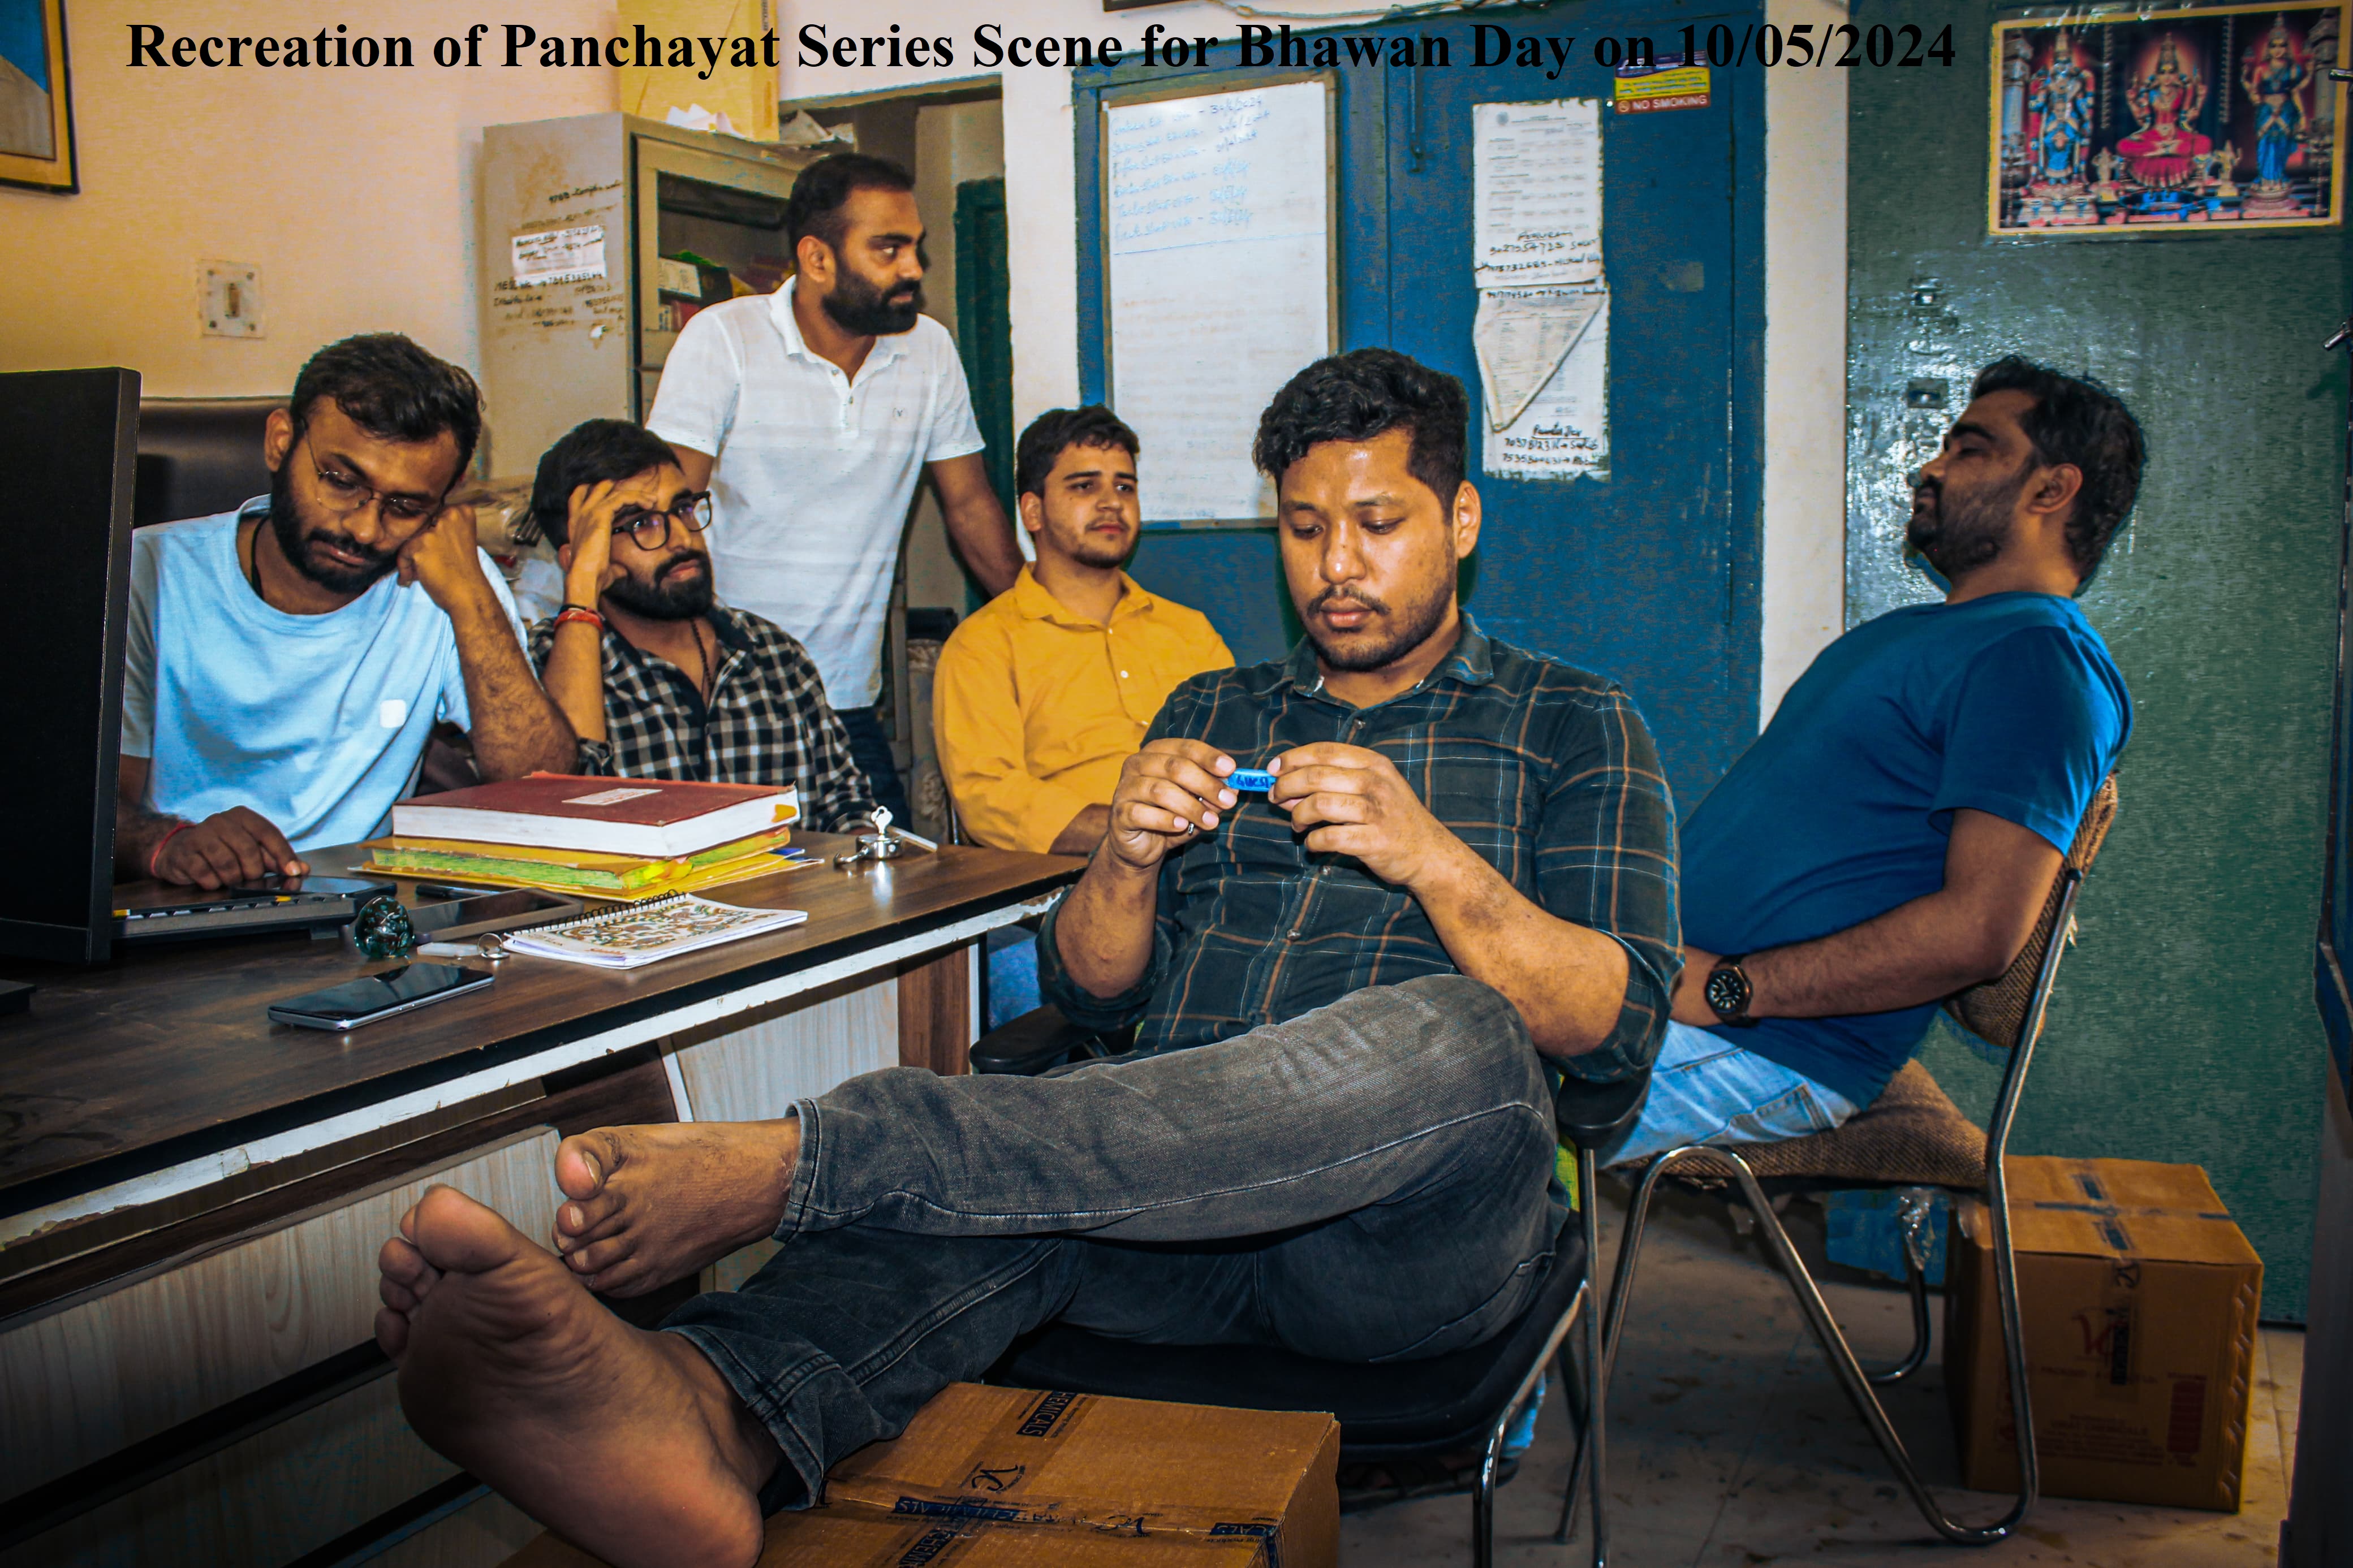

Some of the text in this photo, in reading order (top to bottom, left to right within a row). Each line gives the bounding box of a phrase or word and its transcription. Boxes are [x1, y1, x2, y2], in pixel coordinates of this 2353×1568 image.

[1632, 95, 1708, 109] NO SMOKING
[1022, 1391, 1077, 1436] HEMICALS
